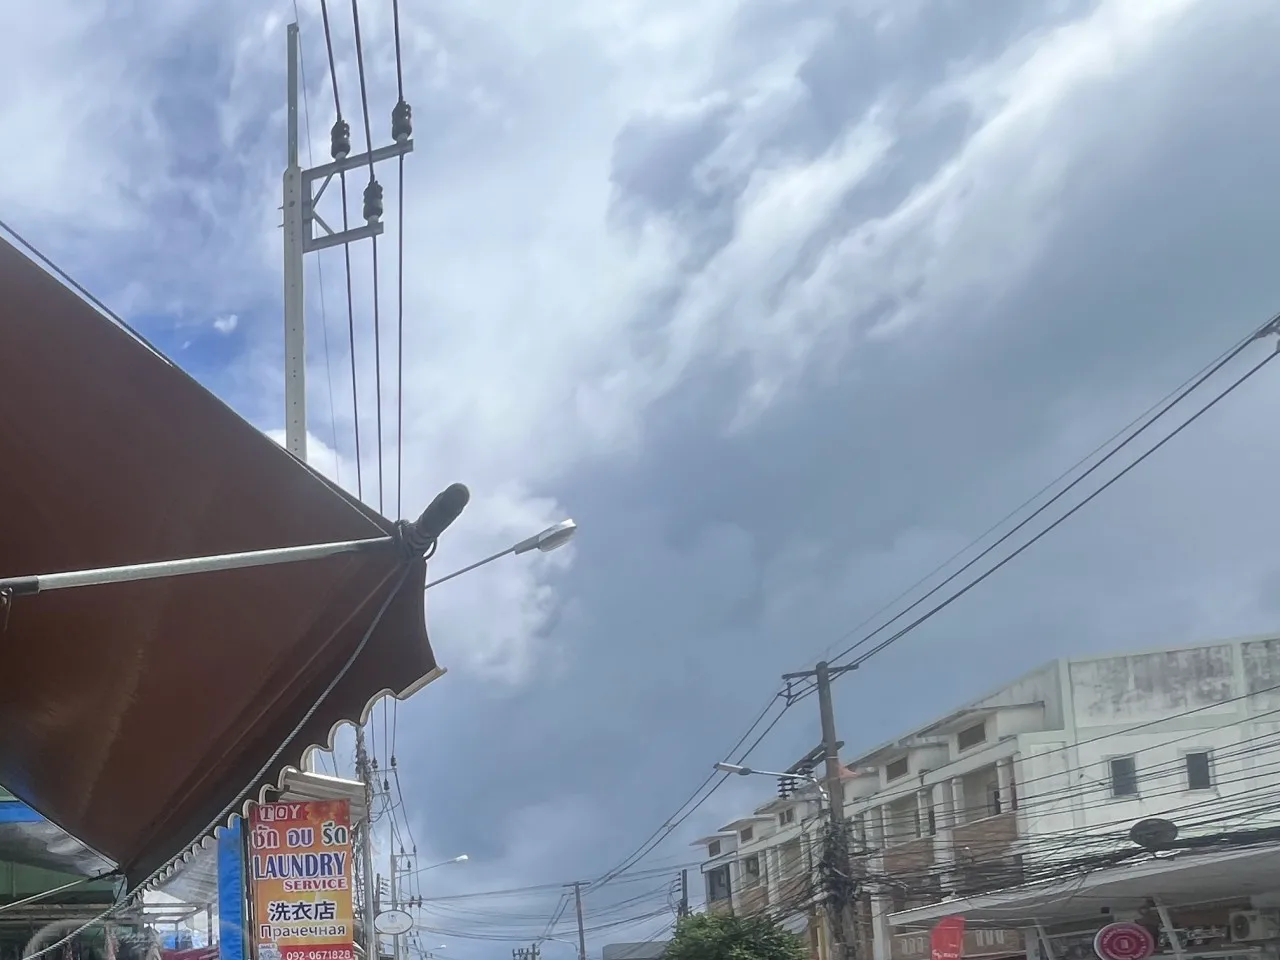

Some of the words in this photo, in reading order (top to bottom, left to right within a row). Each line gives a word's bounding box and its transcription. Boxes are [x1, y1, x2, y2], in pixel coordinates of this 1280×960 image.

[260, 805, 300, 821] TOY
[286, 828, 314, 848] อบ
[322, 821, 348, 846] รีด
[253, 851, 346, 880] LAUNDRY
[284, 878, 348, 892] SERVICE
[268, 900, 336, 922] 洗衣店
[260, 923, 346, 940] Прачечная
[286, 949, 351, 960] 092-0671828
